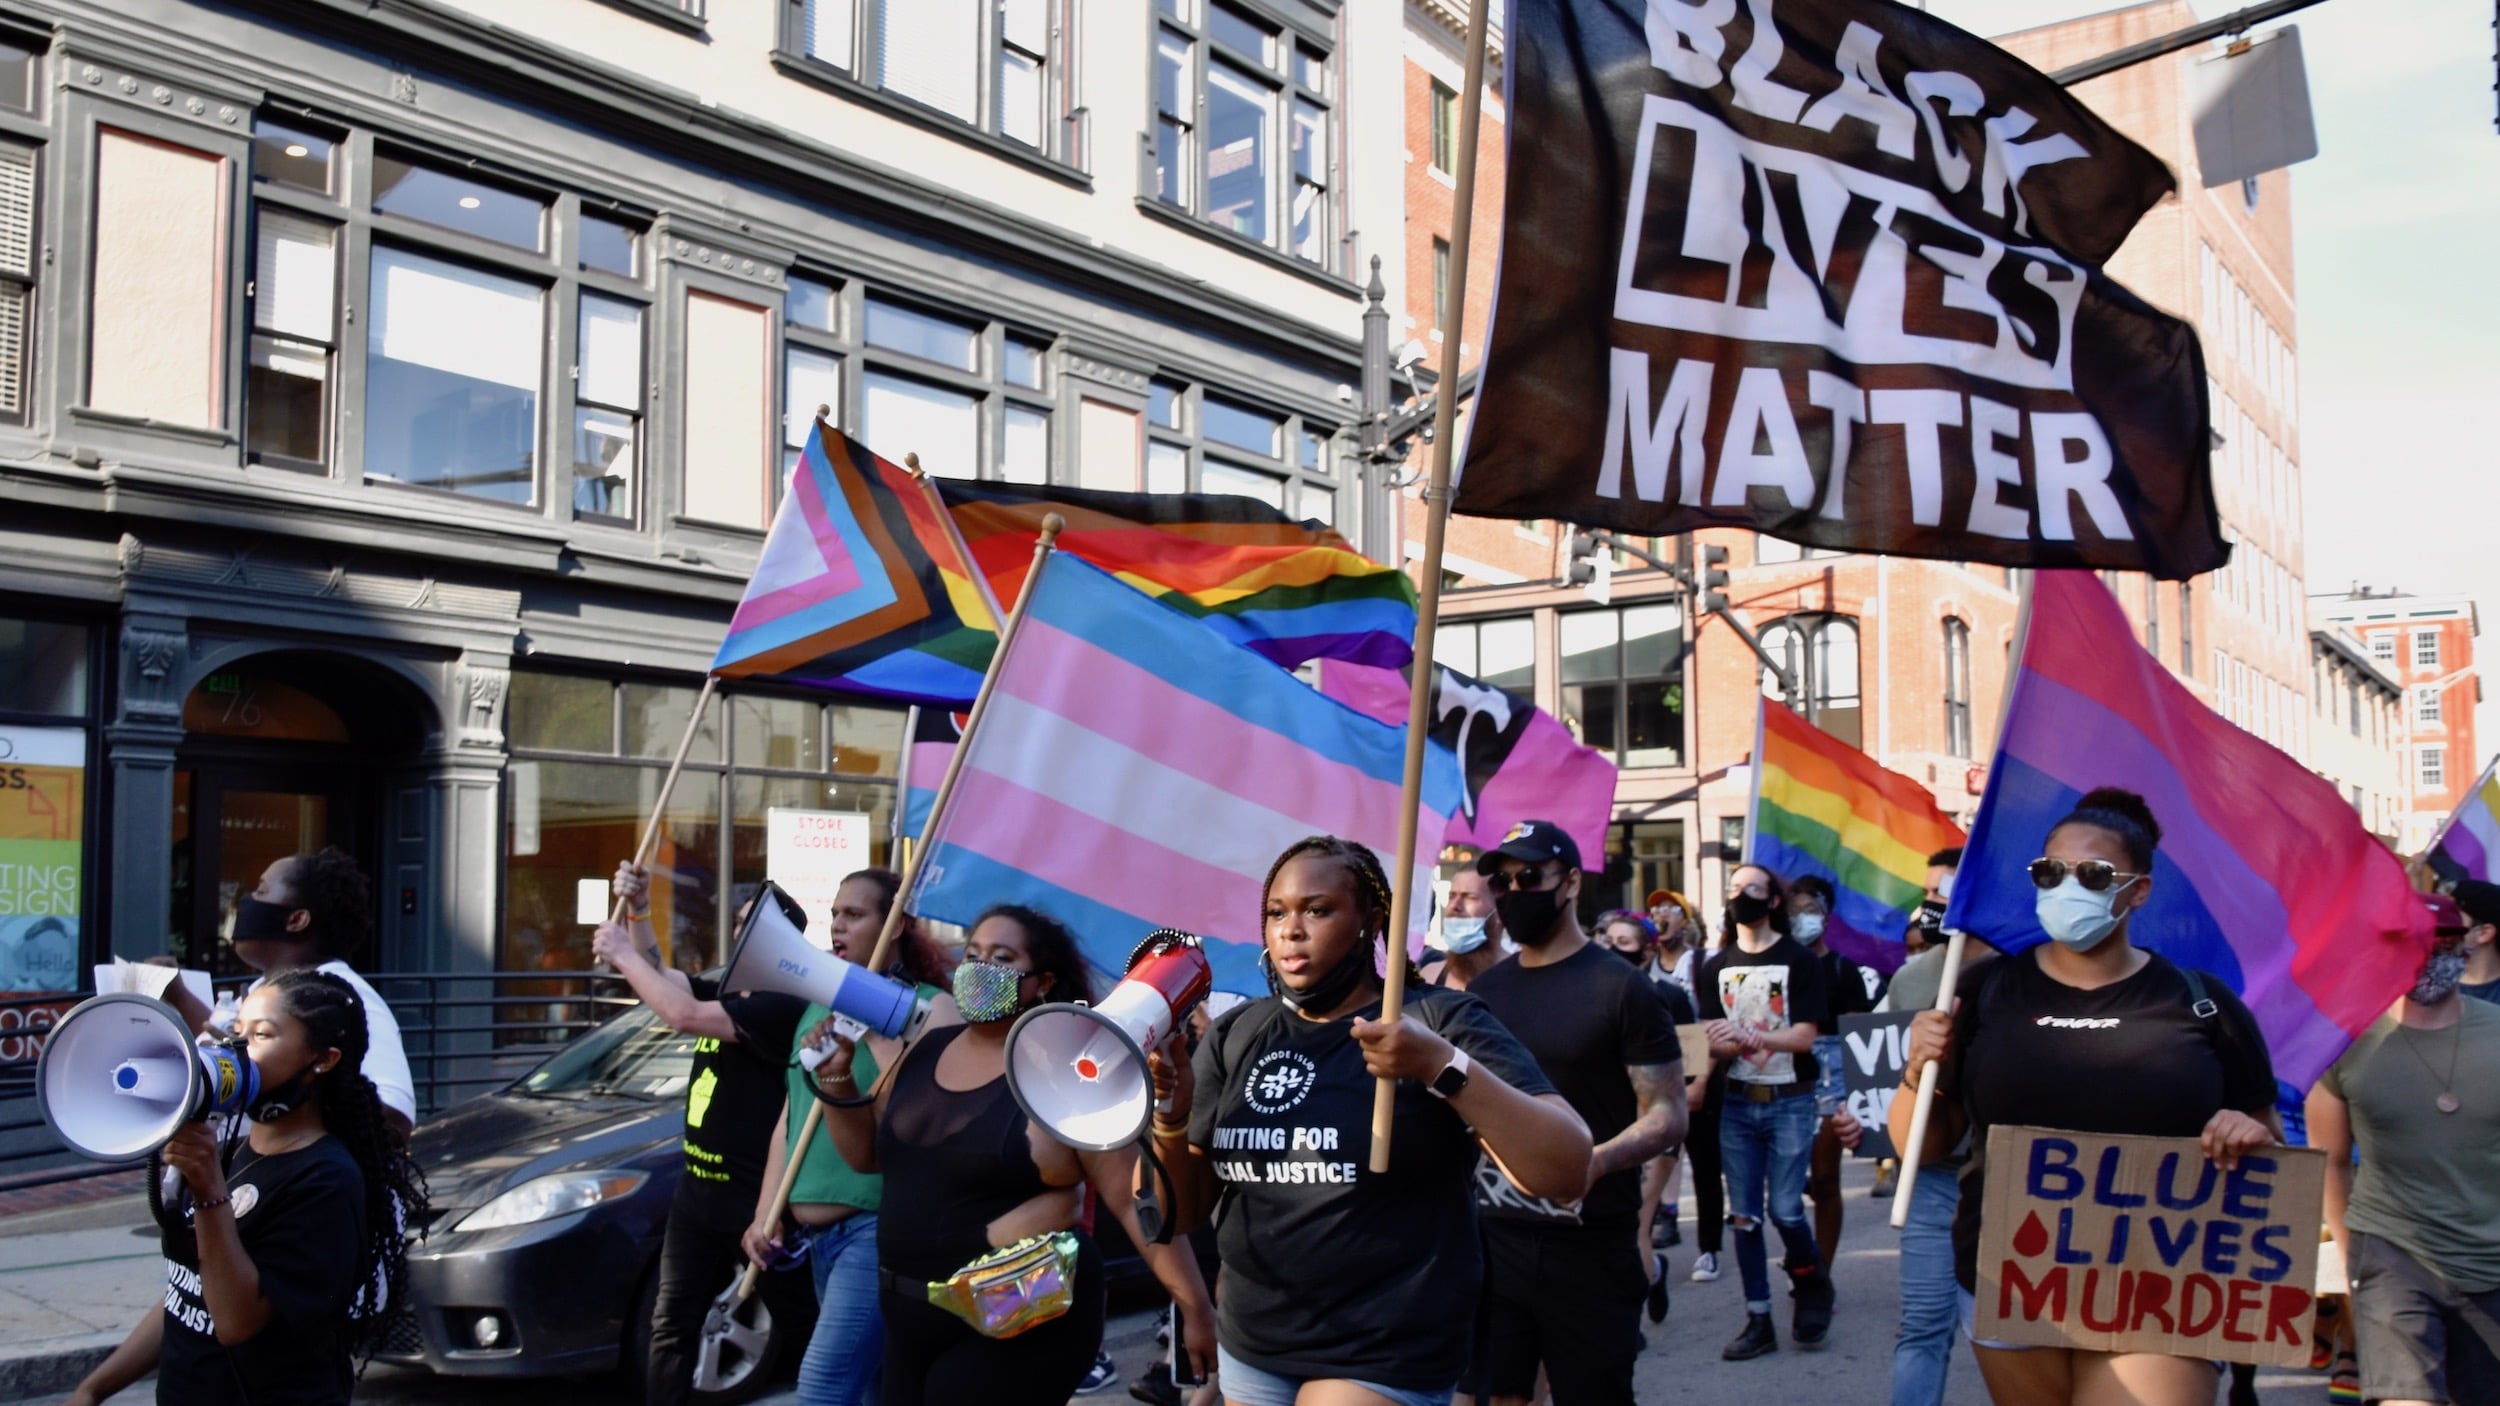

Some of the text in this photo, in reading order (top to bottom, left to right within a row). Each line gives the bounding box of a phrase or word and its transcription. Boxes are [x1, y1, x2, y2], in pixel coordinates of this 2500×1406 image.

[1645, 0, 2091, 239] BLACK
[1631, 121, 2076, 371] LIVES
[1595, 347, 2135, 541] MATTER
[798, 816, 844, 831] STORE
[793, 835, 849, 849] CLOSED
[0, 863, 77, 892] TING
[0, 889, 76, 915] SIGN
[25, 951, 75, 972] Hello
[778, 958, 809, 978] PYLE
[1258, 1050, 1291, 1067] RHODE
[1277, 1102, 1291, 1113] OF
[1212, 1126, 1339, 1151] UNITING FOR
[1265, 1161, 1358, 1184] JUSTICE
[2026, 1137, 2279, 1221] BLUE
[2054, 1206, 2293, 1283] LIVES
[164, 1257, 203, 1297] NITING
[1998, 1258, 2314, 1347] MURDER
